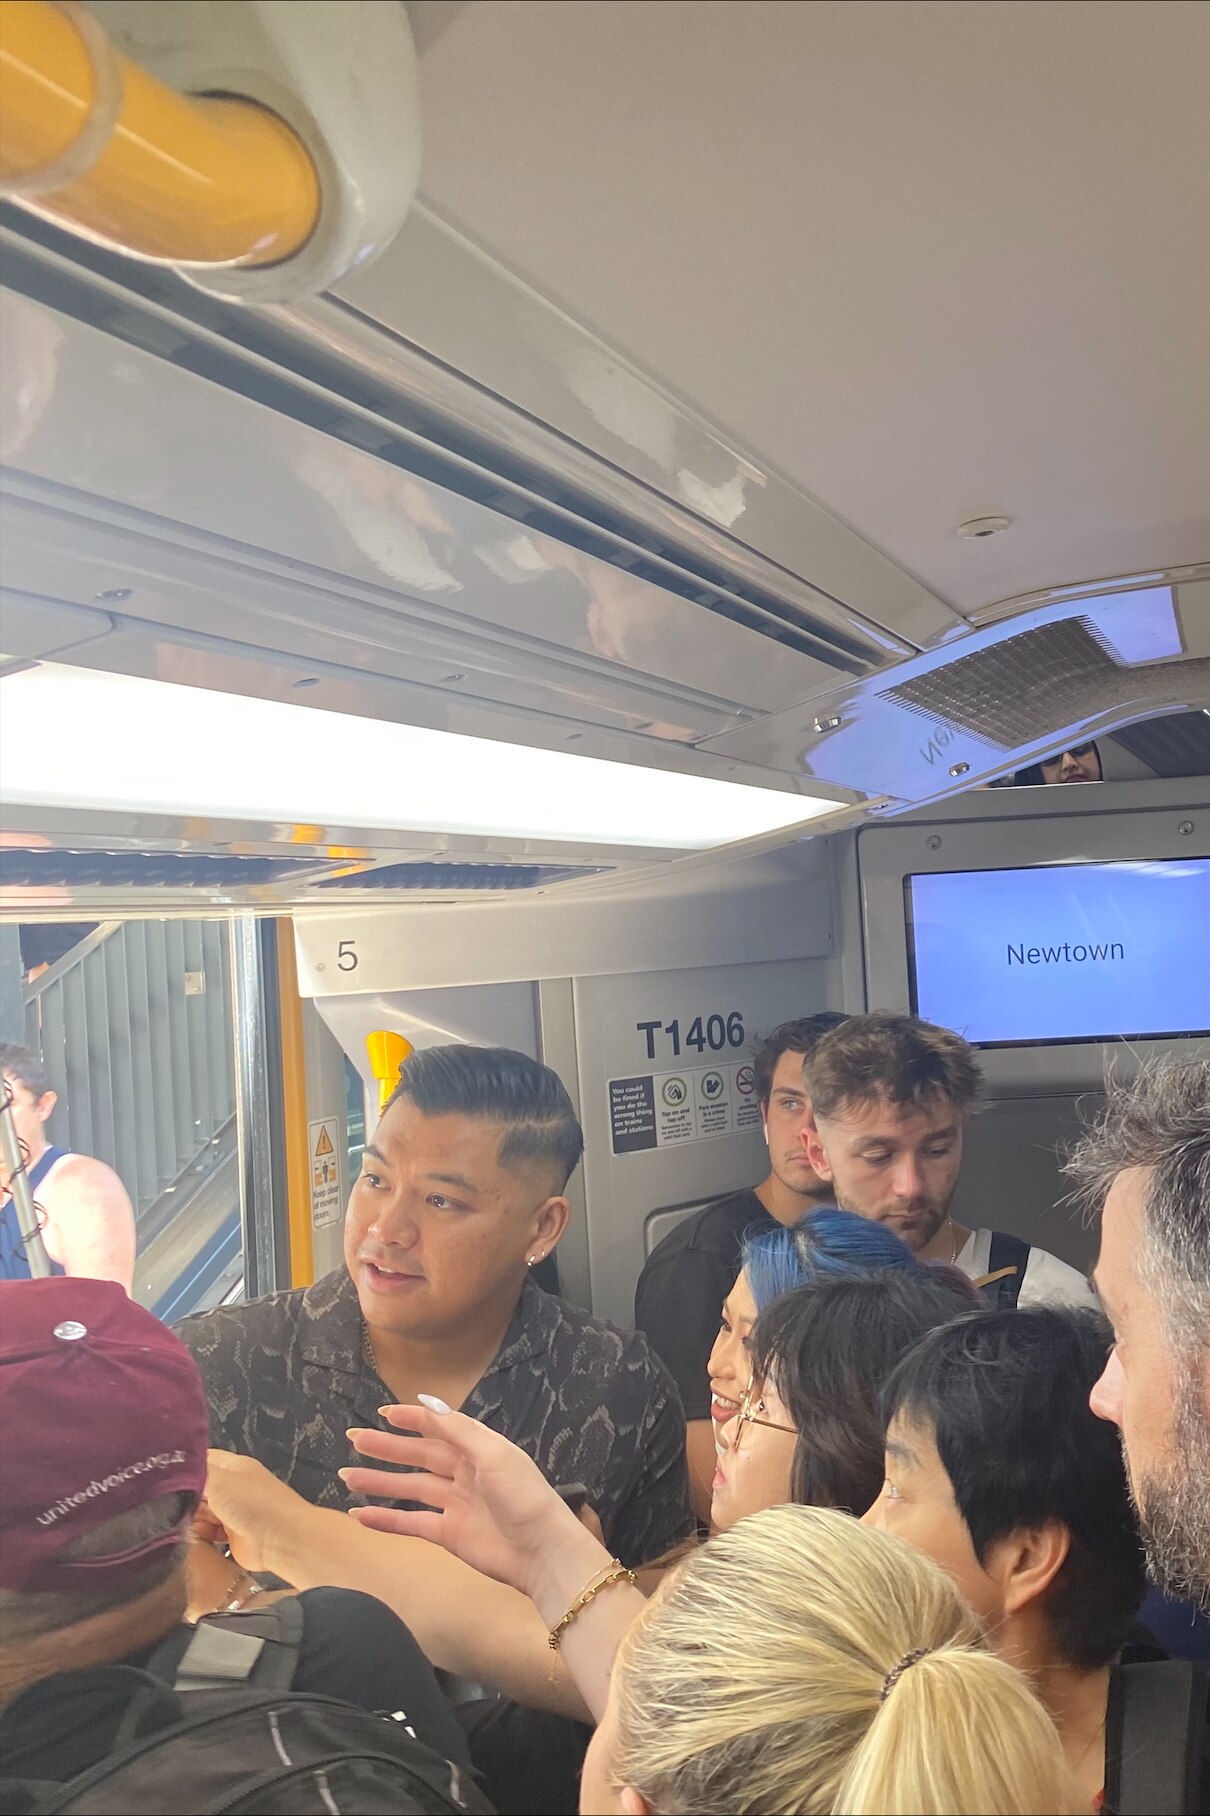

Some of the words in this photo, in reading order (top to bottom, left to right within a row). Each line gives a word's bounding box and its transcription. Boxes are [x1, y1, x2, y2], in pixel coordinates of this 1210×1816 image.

[337, 940, 358, 971] 5
[1006, 942, 1124, 965] Newtown
[636, 1011, 745, 1059] T1406
[625, 1084, 643, 1093] could
[622, 1093, 639, 1102] fined
[613, 1104, 626, 1113] you
[613, 1111, 635, 1120] wrong
[636, 1108, 653, 1116] thing
[624, 1118, 643, 1126] trains
[628, 1124, 654, 1133] stations
[313, 1190, 326, 1199] Keep
